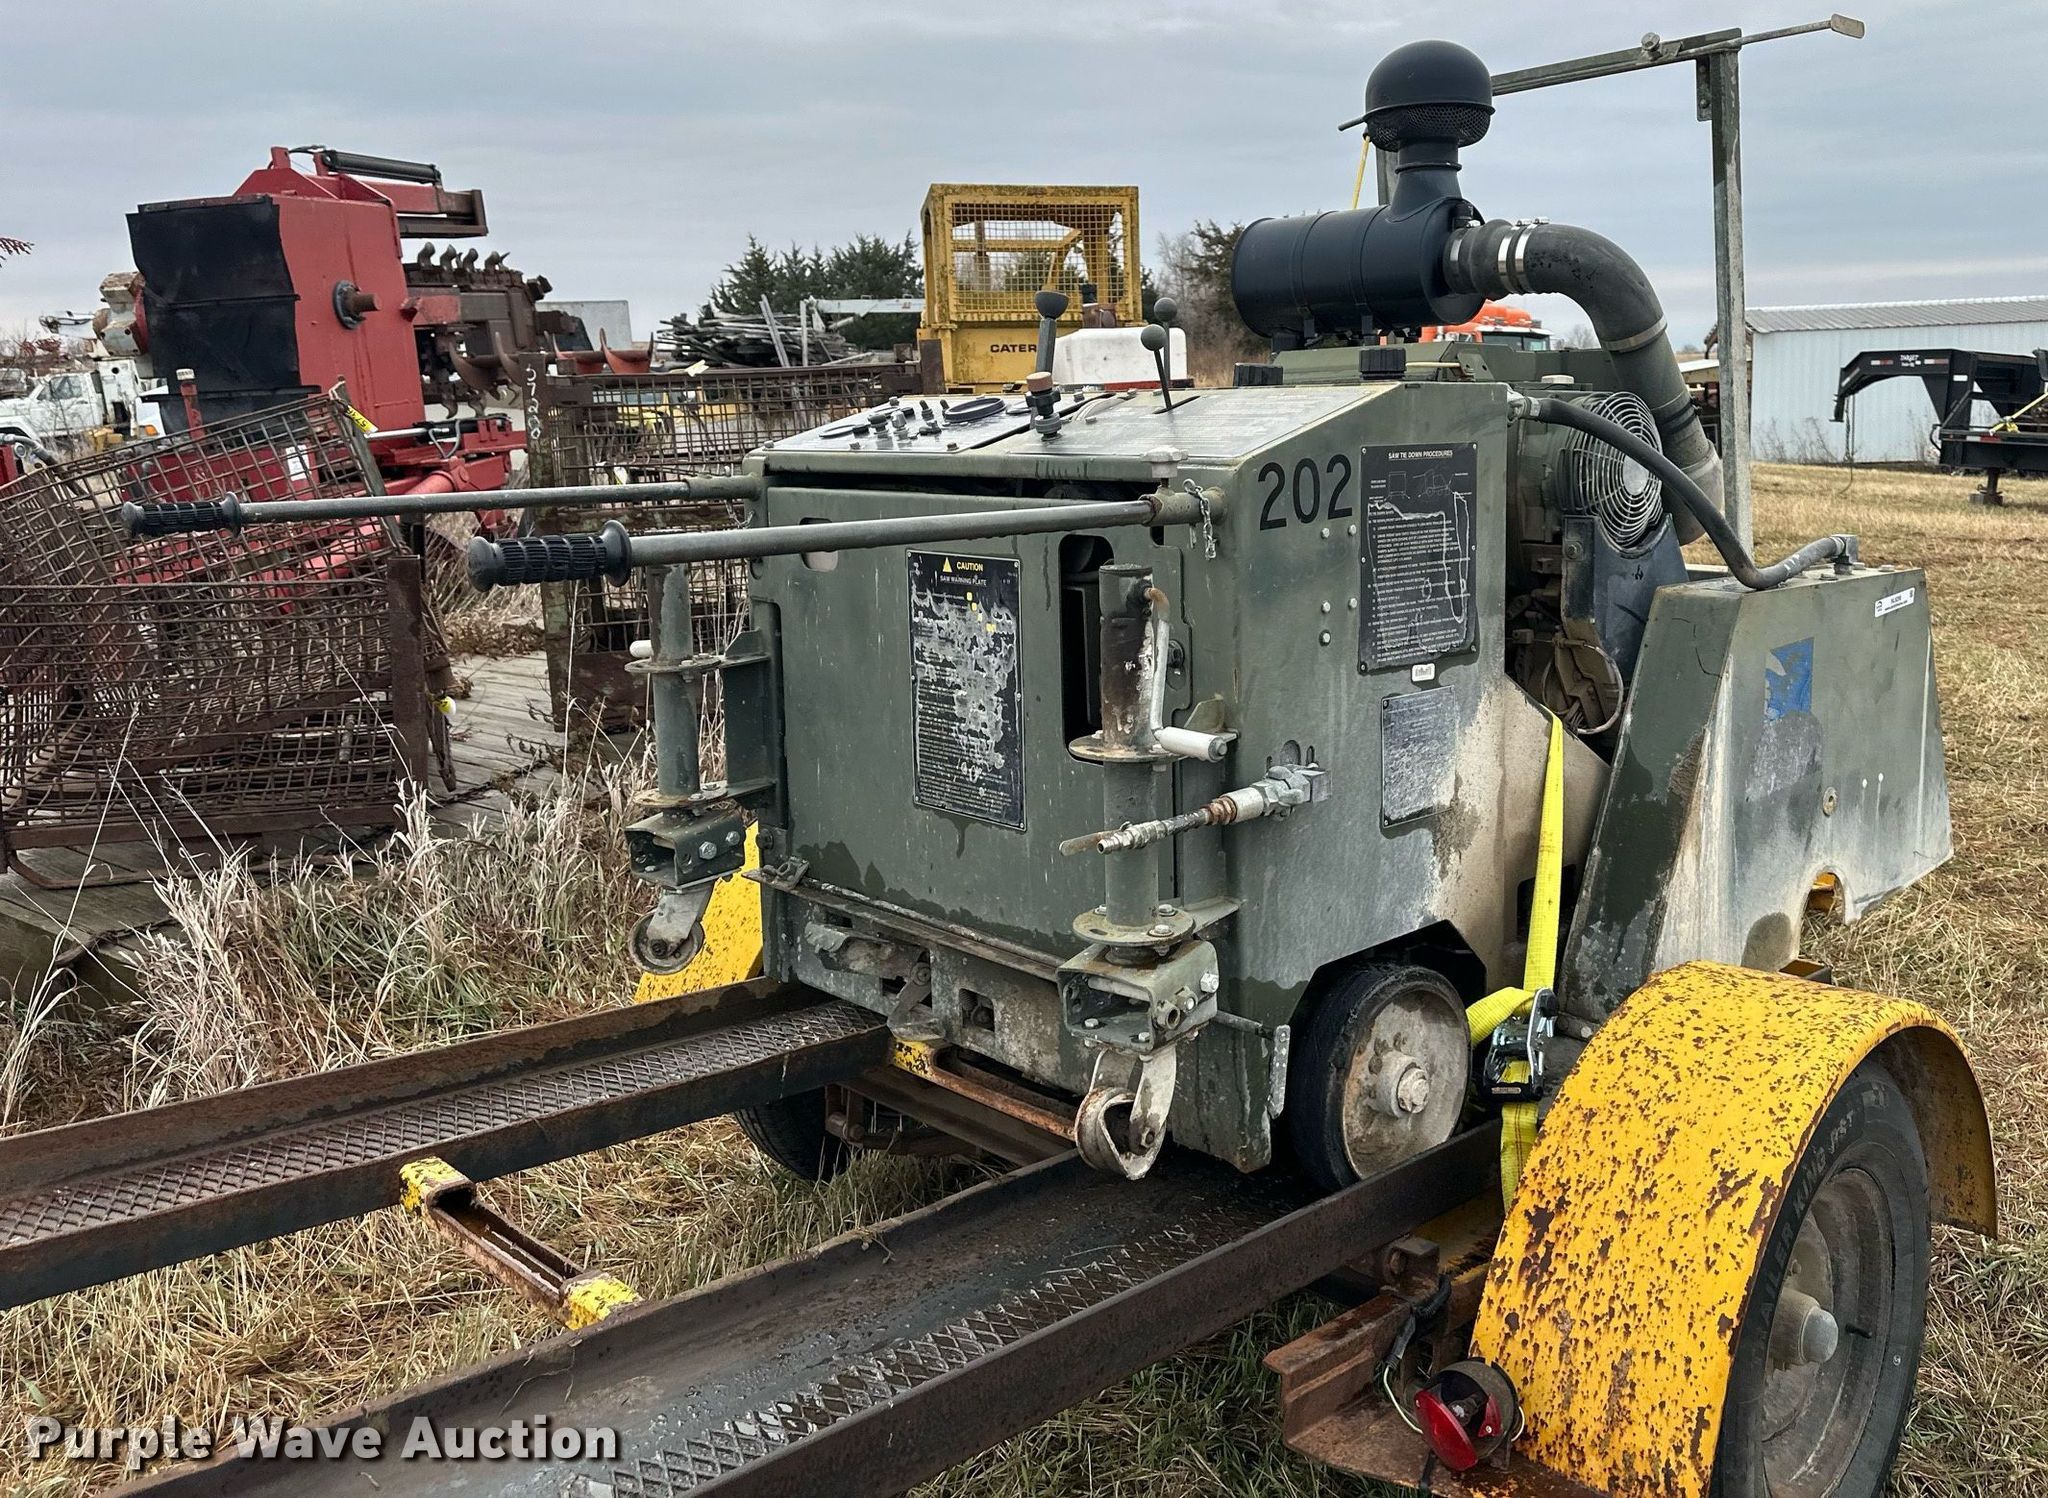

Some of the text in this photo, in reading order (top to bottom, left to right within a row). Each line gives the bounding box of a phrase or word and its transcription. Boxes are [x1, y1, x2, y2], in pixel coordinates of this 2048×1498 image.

[1400, 451, 1408, 459] TIE
[1423, 450, 1453, 458] PROCEDURES
[1258, 454, 1352, 530] 202
[957, 561, 984, 572] CAUTION
[951, 576, 972, 585] WARNING
